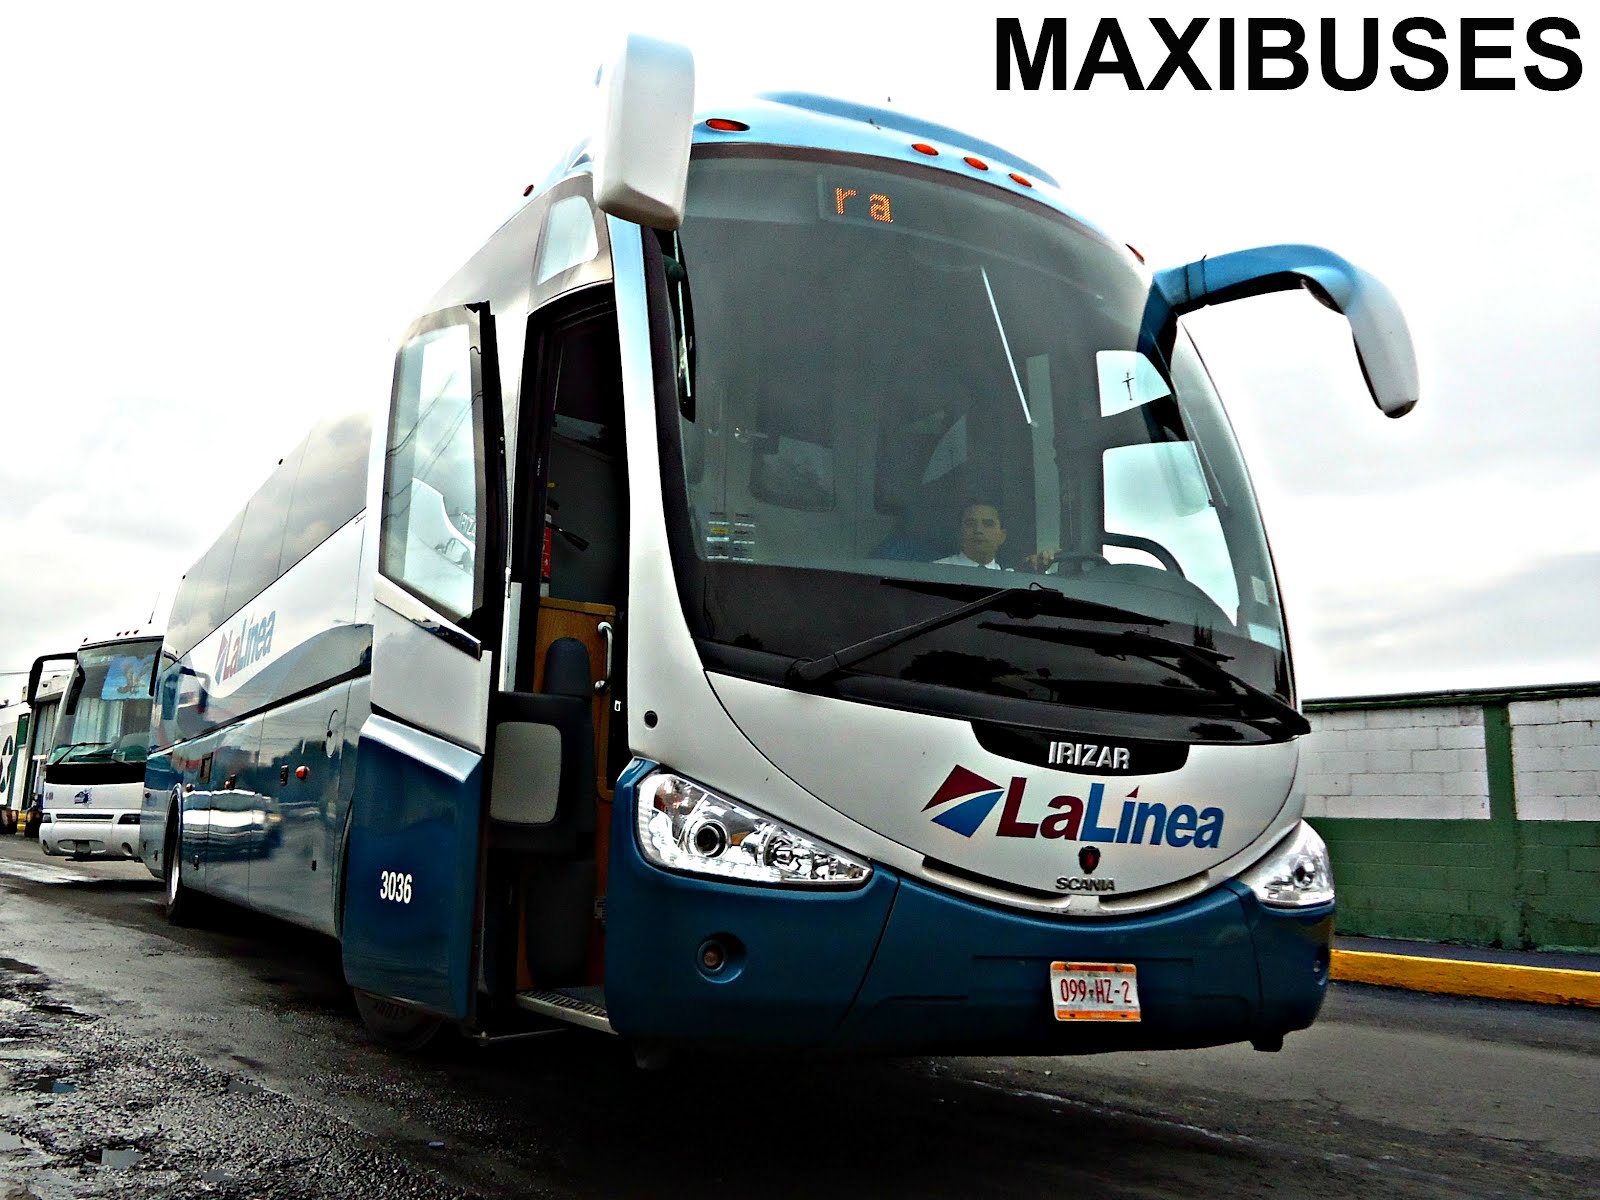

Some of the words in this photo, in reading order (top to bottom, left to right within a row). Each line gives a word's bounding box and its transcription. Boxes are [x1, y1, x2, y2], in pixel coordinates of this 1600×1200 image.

[1048, 741, 1130, 769] IRIZAR
[380, 870, 412, 904] 3036
[1055, 876, 1115, 891] SCANIA
